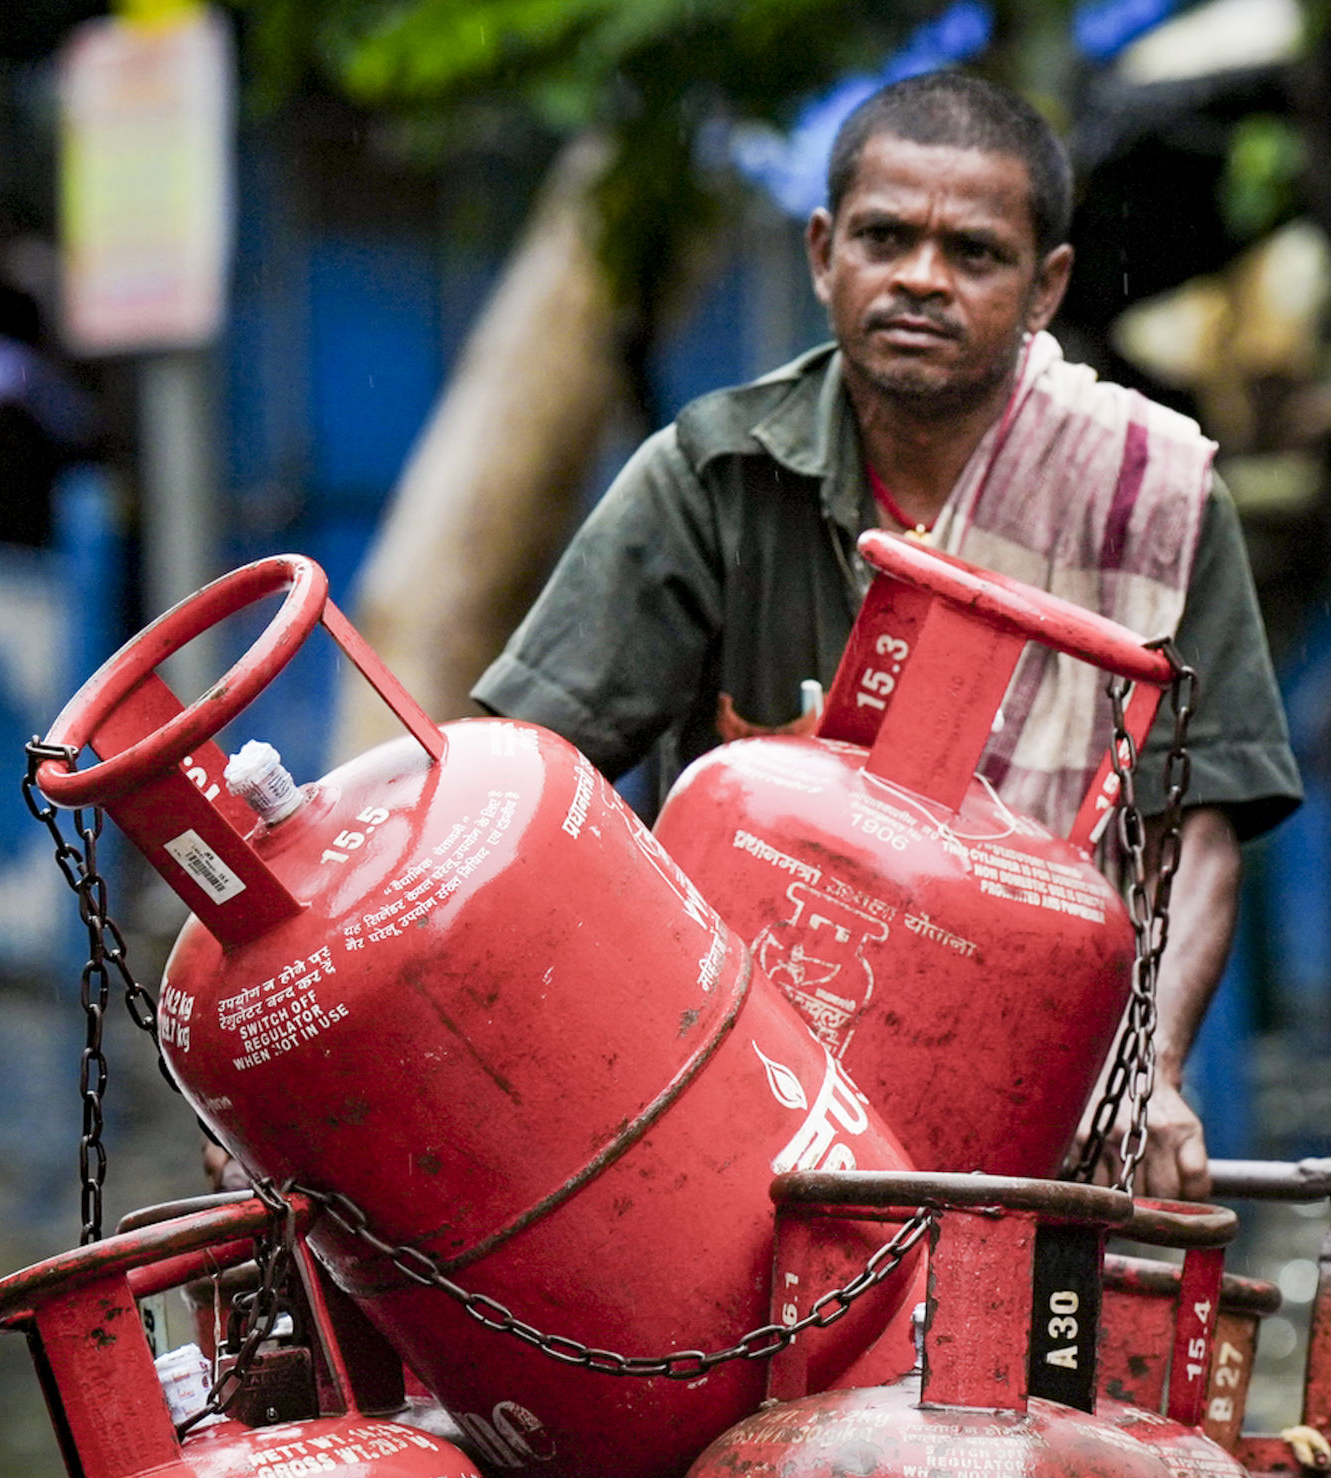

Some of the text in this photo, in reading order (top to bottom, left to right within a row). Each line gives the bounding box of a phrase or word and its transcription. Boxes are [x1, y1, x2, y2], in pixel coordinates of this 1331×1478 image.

[857, 634, 909, 710] 15.3
[320, 806, 390, 864] 15.5
[850, 813, 909, 851] 1906
[218, 985, 261, 1013] उपयोग
[278, 959, 307, 985] होने
[307, 945, 332, 965] पर
[295, 969, 323, 990] कर
[232, 1049, 271, 1071] WHEN
[301, 1025, 319, 1041] IN
[320, 1003, 350, 1029] USE
[239, 989, 318, 1041] SWITCH OFF
[244, 1004, 325, 1054] REGULATOR
[782, 1272, 799, 1344] 6.1
[247, 1442, 309, 1468] NETT
[926, 1455, 1025, 1471] REGULATOR
